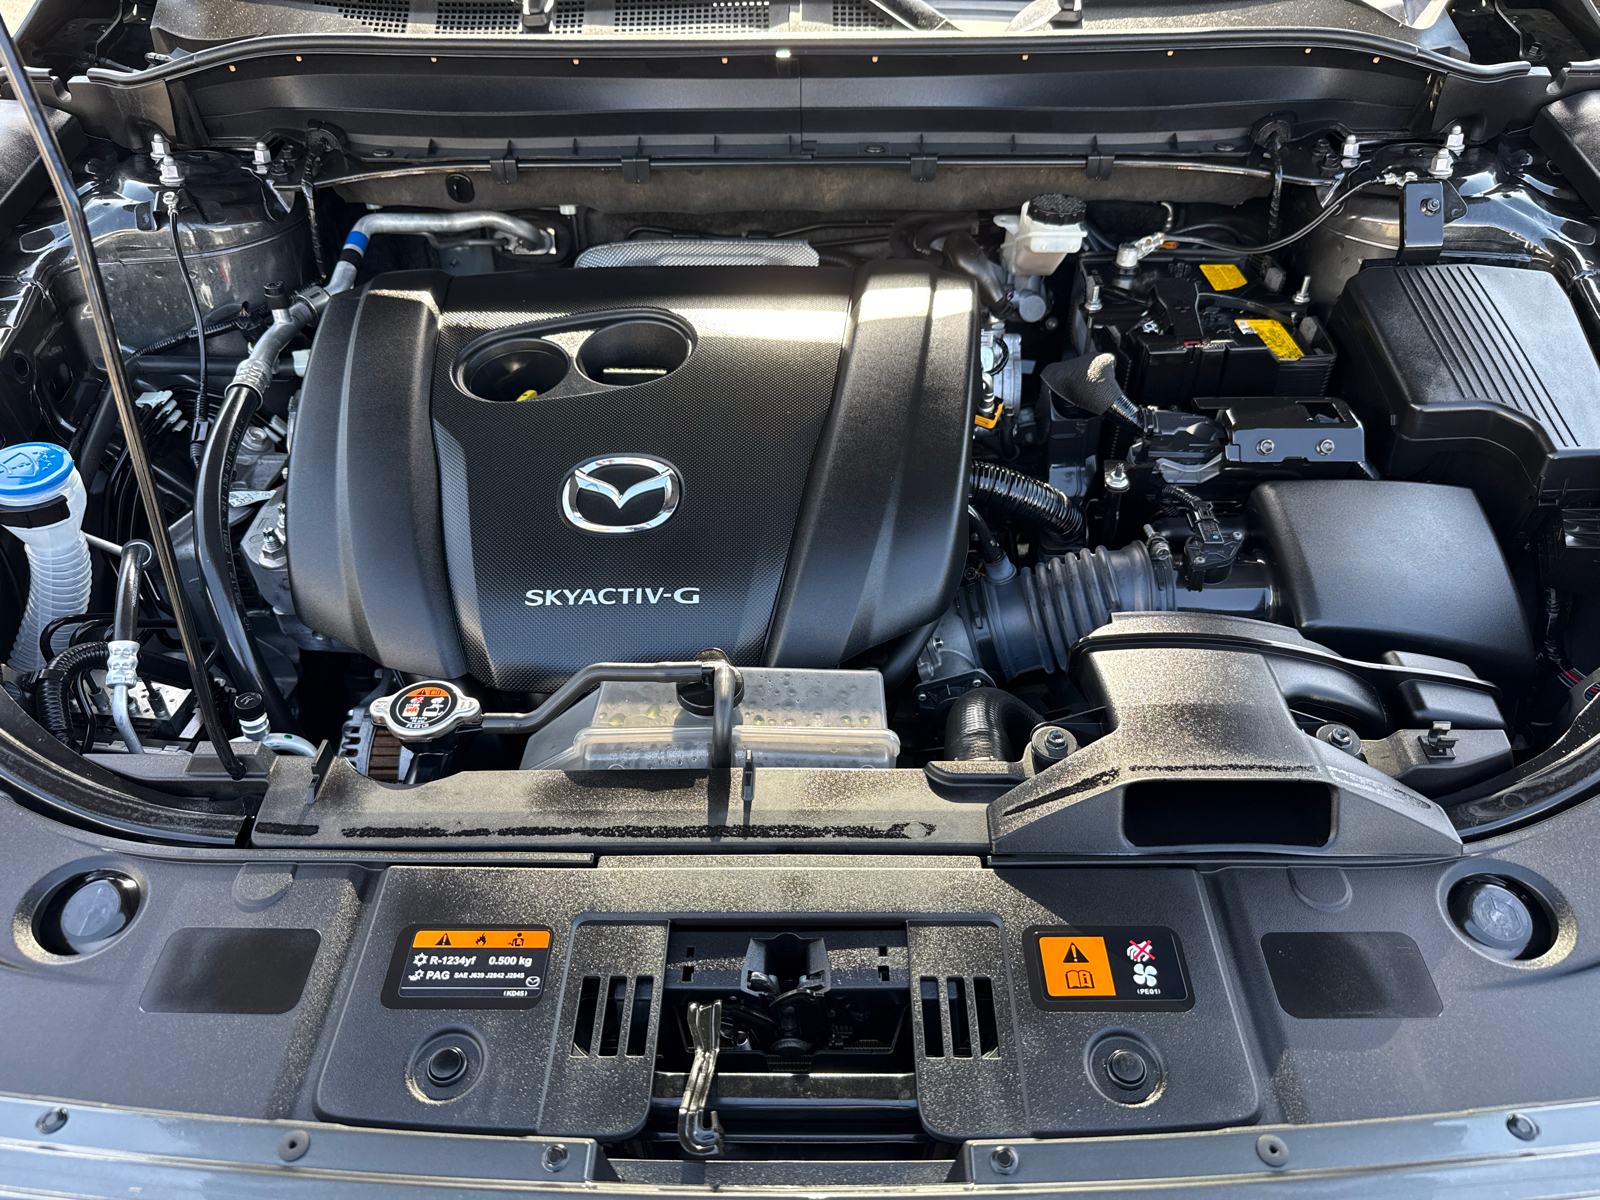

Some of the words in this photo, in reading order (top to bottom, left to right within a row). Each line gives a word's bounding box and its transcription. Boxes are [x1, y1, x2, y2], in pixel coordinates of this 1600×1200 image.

[524, 587, 700, 606] SKYACTIV-G
[429, 955, 477, 967] R-1234yf
[488, 956, 517, 965] 0.500
[518, 956, 533, 967] kg
[425, 971, 450, 980] PAG
